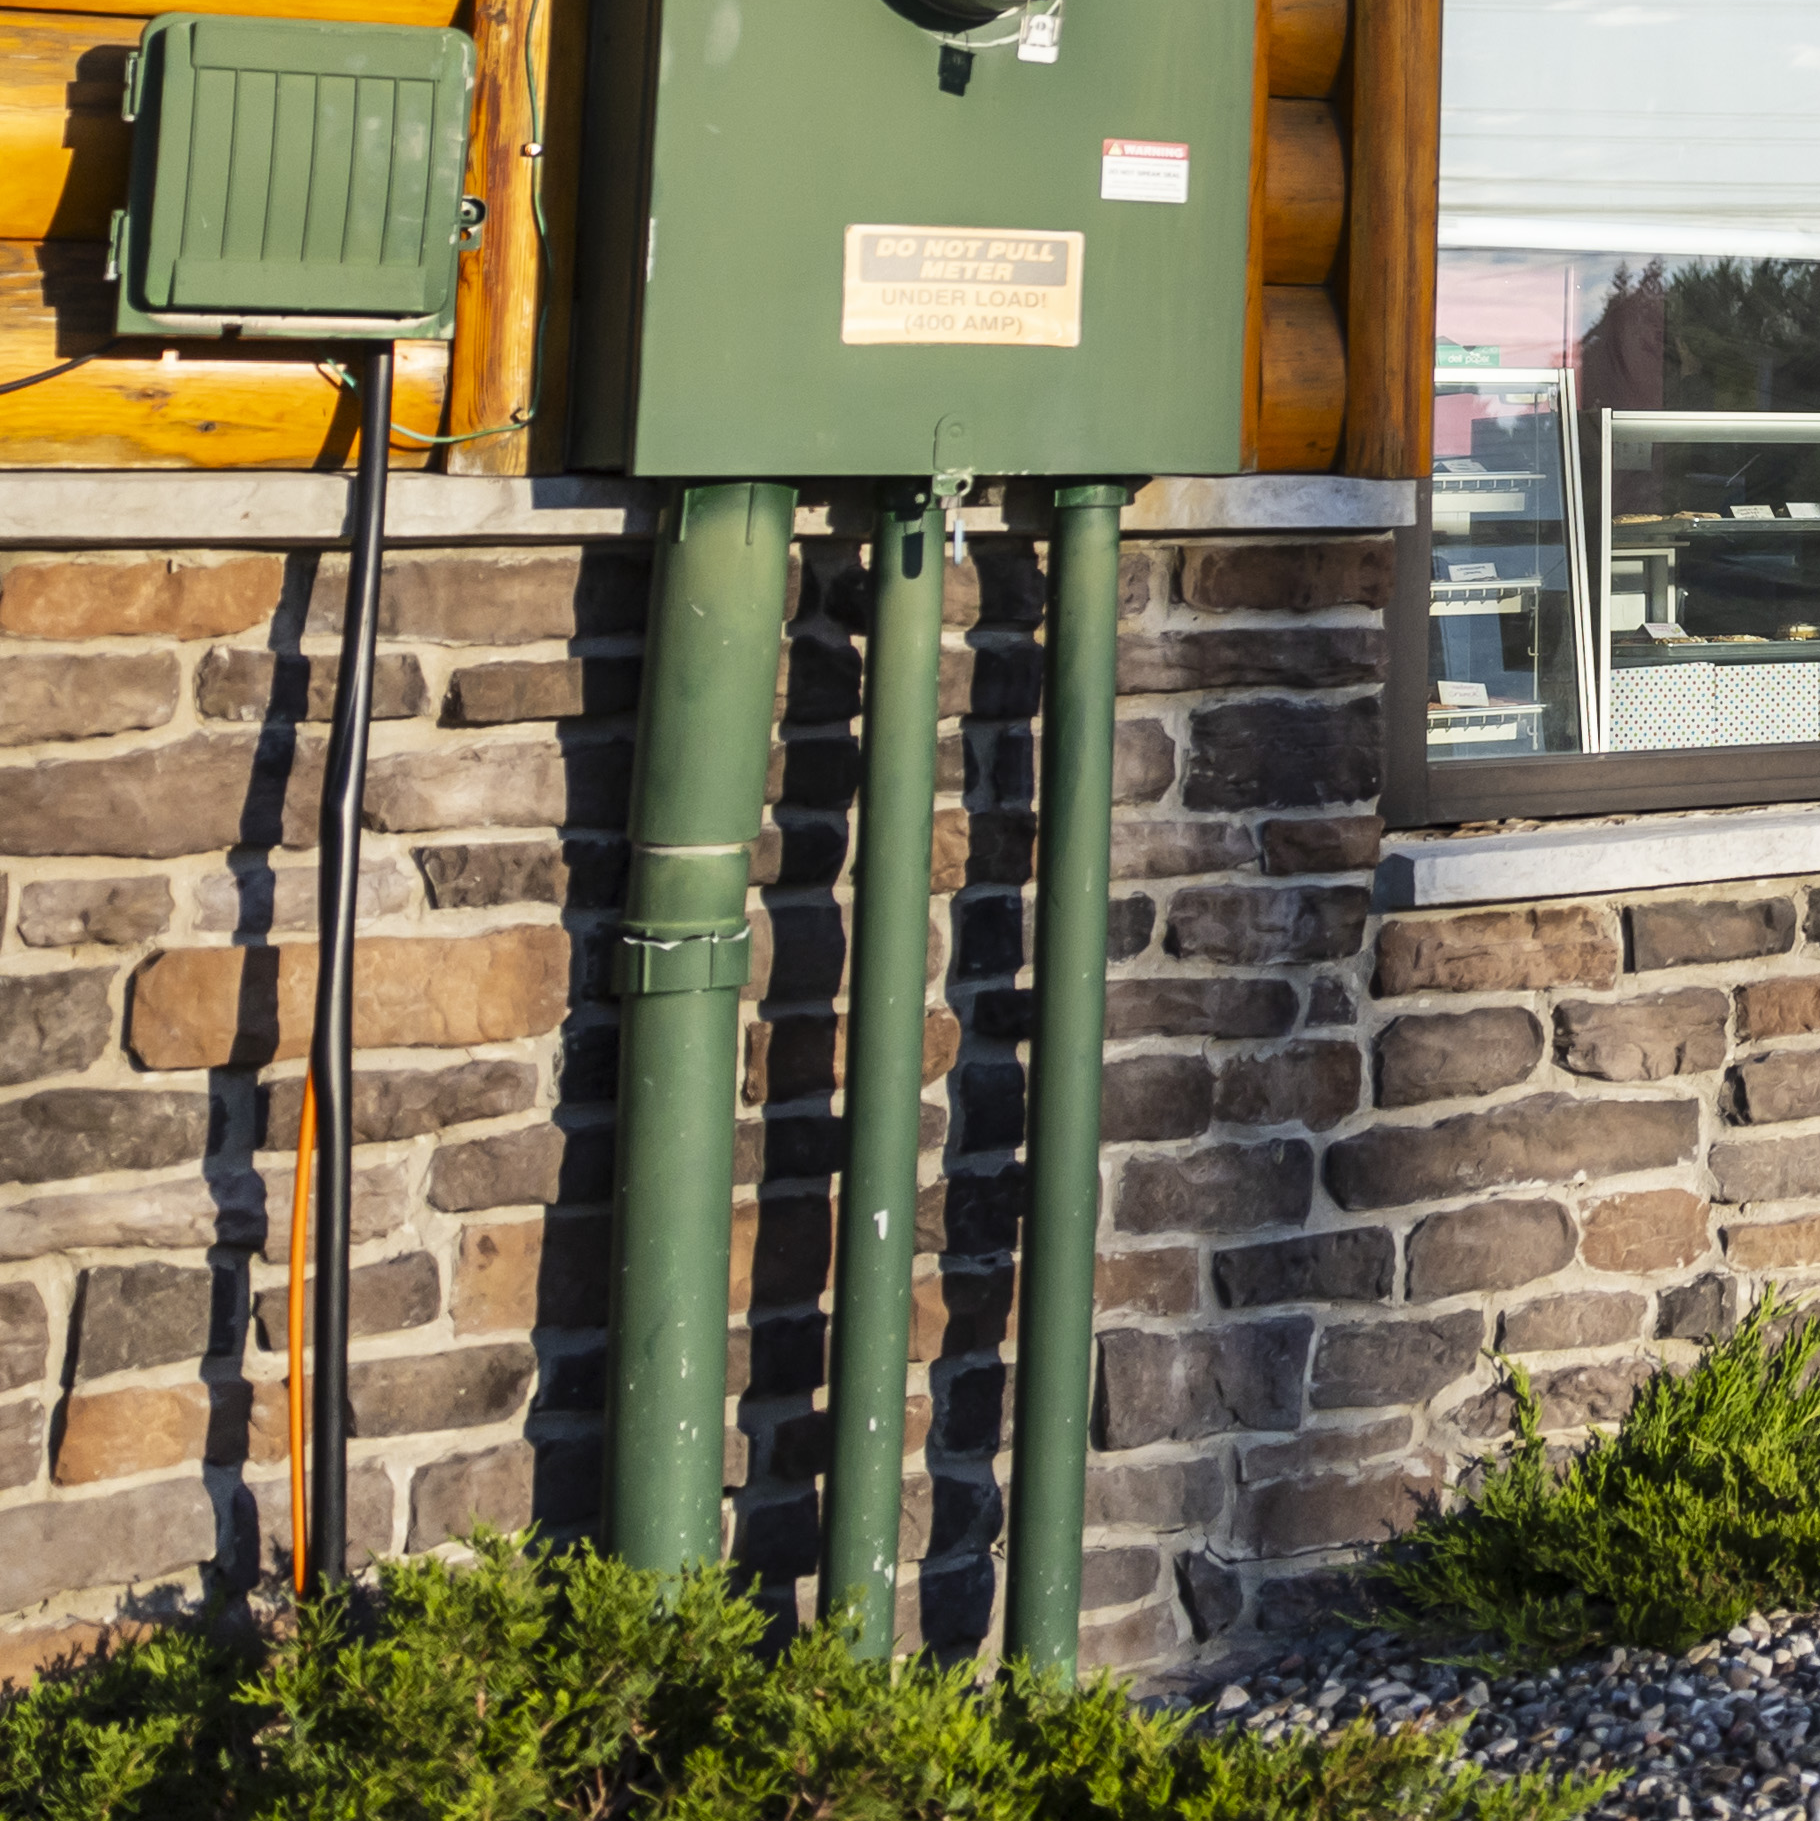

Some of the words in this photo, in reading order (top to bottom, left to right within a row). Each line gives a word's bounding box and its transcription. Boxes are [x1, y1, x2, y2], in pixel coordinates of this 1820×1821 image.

[1123, 144, 1184, 159] WARNING
[875, 237, 918, 258] DO
[922, 239, 983, 260] NOT
[986, 242, 1056, 263] PULL
[919, 260, 1016, 282] METER
[881, 287, 966, 307] UNDER
[974, 290, 1048, 309] LOAD!
[904, 314, 955, 335] (400
[962, 315, 1024, 336] AMP)
